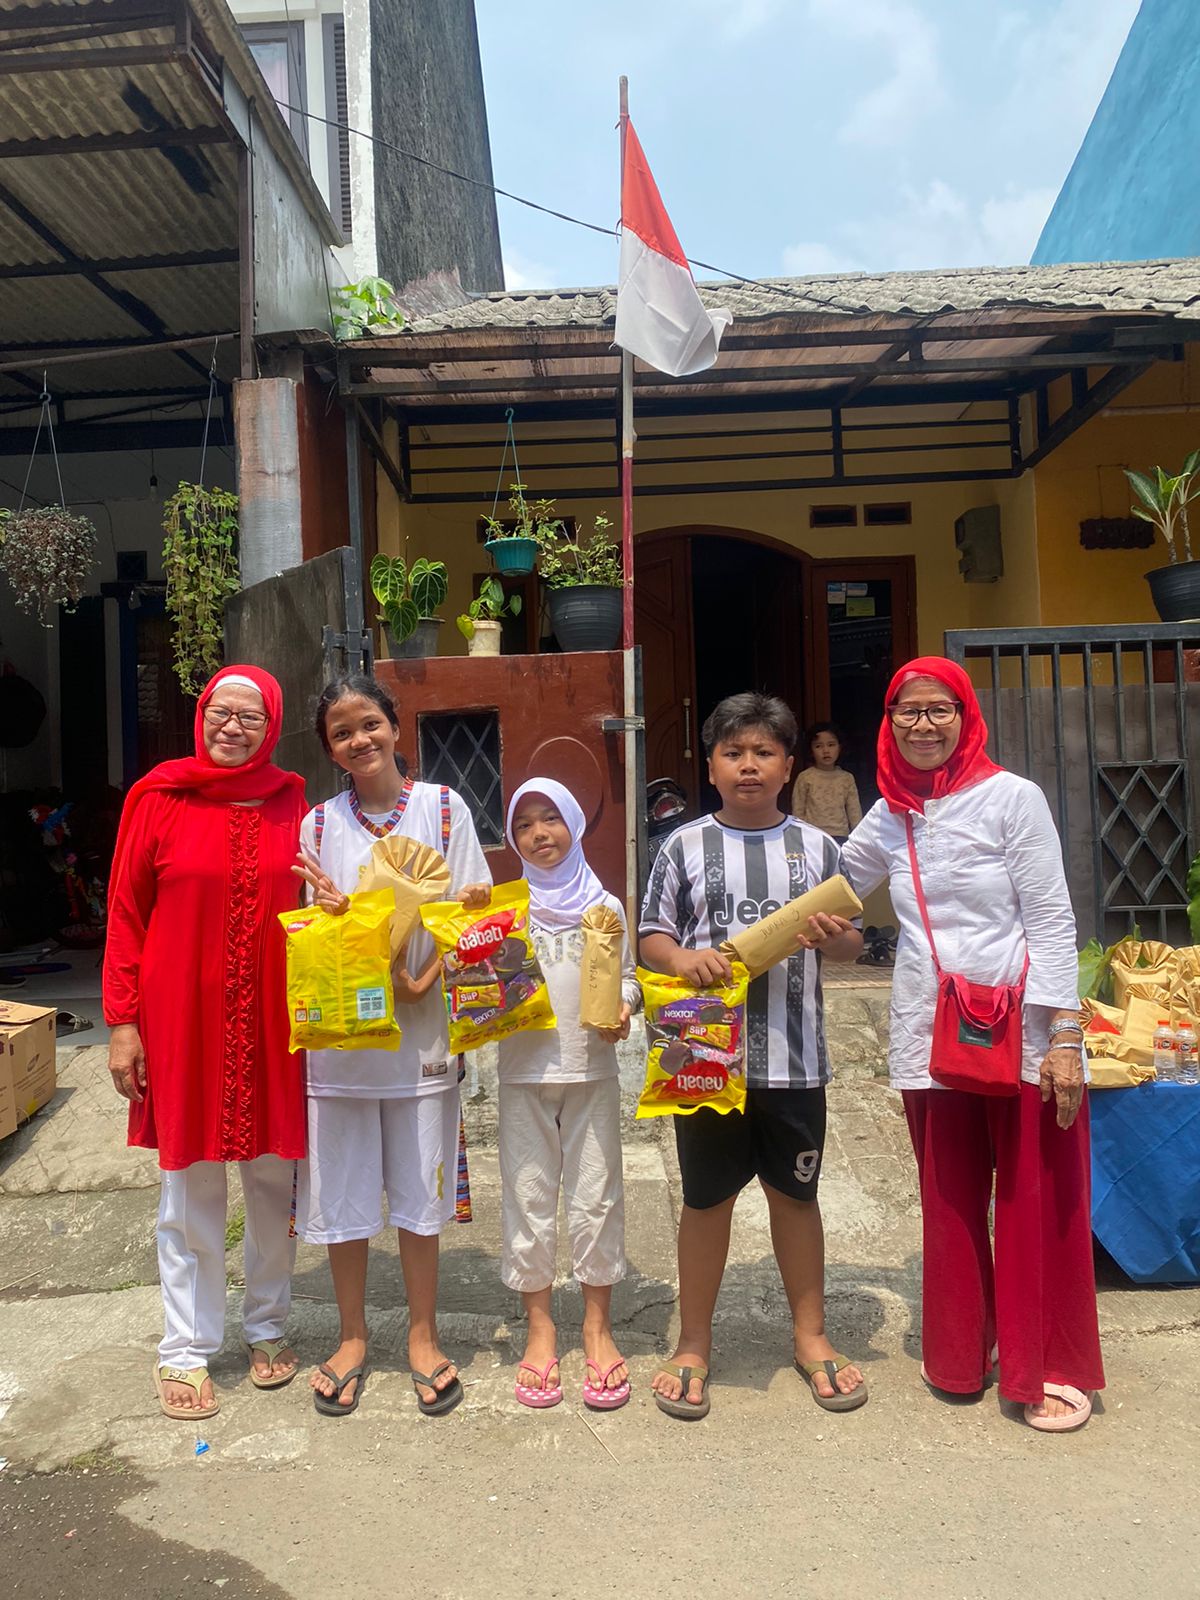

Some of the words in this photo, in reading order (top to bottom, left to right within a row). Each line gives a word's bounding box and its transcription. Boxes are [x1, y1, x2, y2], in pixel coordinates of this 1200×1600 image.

[714, 893, 791, 927] Jee
[459, 925, 503, 950] nabati
[677, 1074, 723, 1091] nabati
